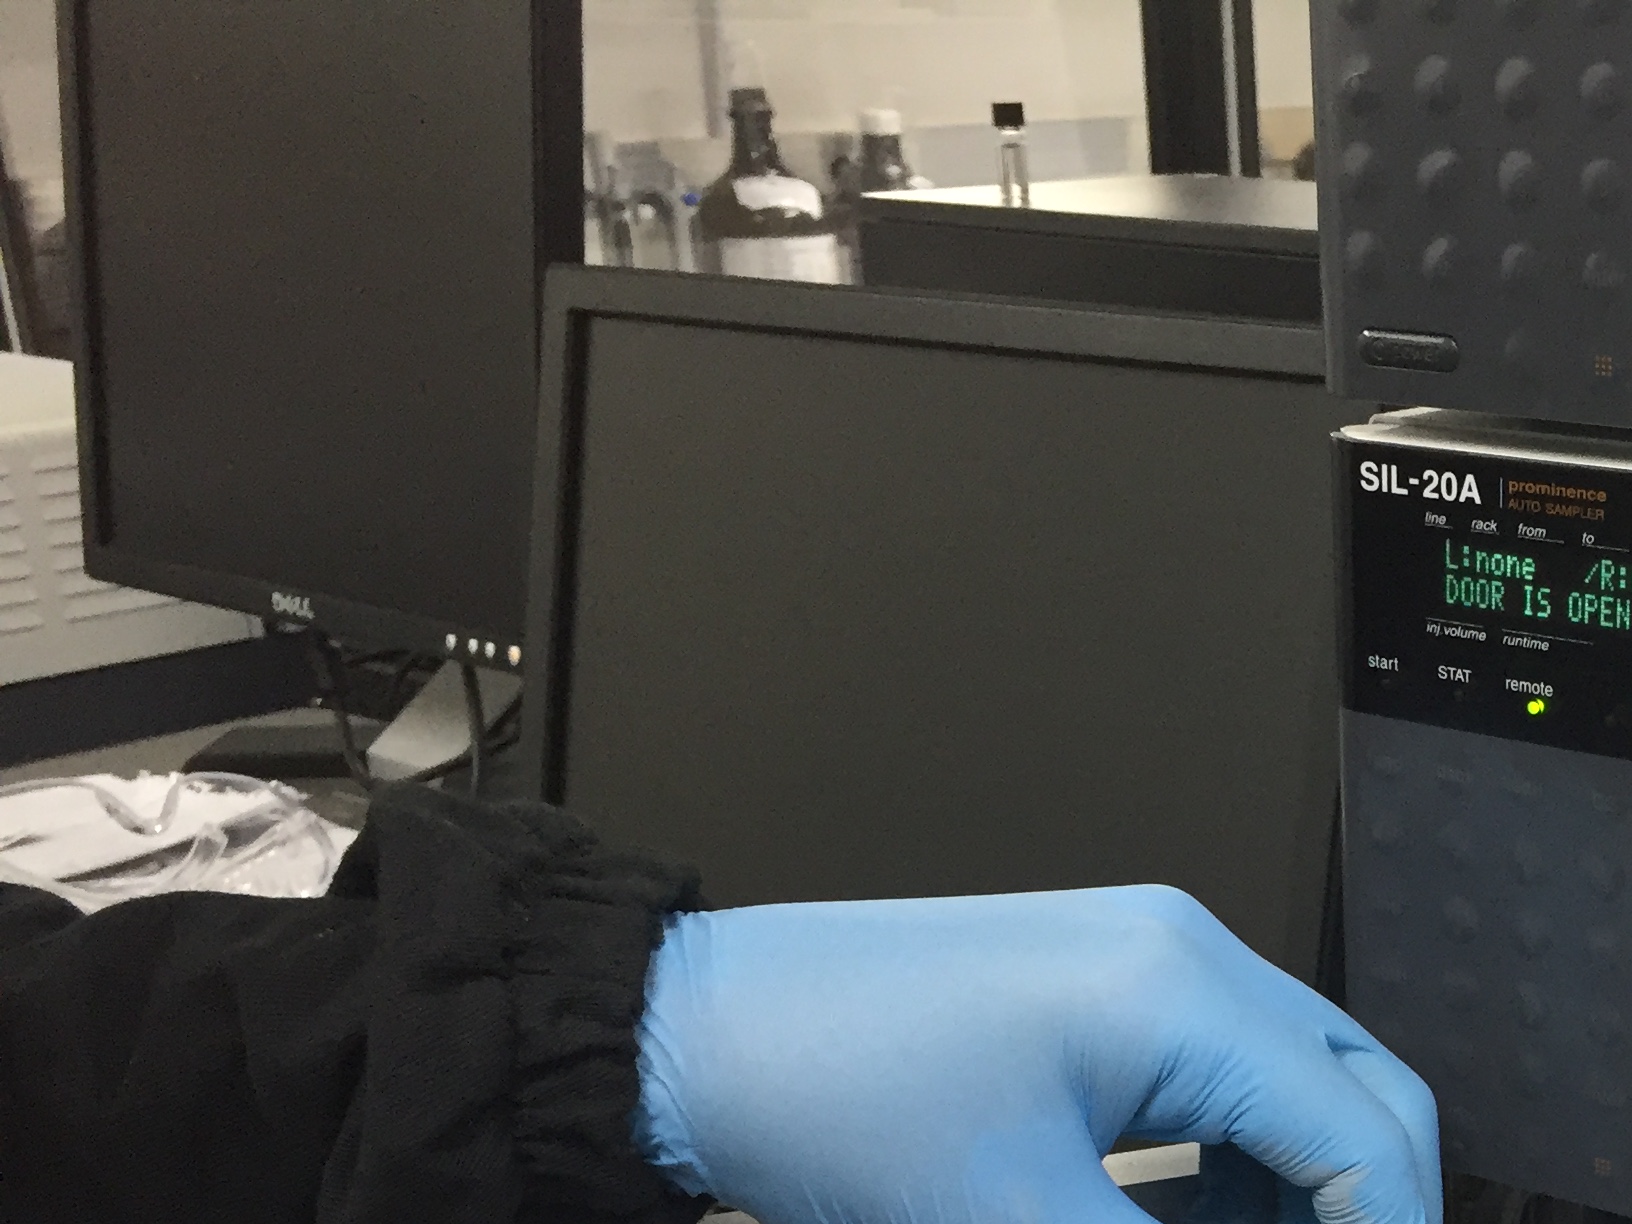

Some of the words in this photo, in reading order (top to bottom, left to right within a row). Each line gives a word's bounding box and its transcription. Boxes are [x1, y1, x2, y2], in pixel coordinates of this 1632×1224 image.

[1359, 461, 1482, 506] SIL-20A
[1508, 479, 1607, 503] prominence
[1424, 511, 1447, 526] line
[1471, 517, 1498, 532] rack
[1517, 523, 1547, 539] from
[1582, 532, 1595, 545] to
[1508, 498, 1541, 513] AUTO
[1545, 502, 1605, 521] SAMPLER
[1446, 538, 1536, 581] L:none
[1446, 574, 1505, 612] DOOR
[1524, 584, 1552, 619] IS
[1568, 592, 1631, 631] OPEN
[1502, 635, 1550, 651] runtime
[1368, 654, 1399, 672] start
[1437, 665, 1472, 684] STAT
[1505, 678, 1554, 697] remote
